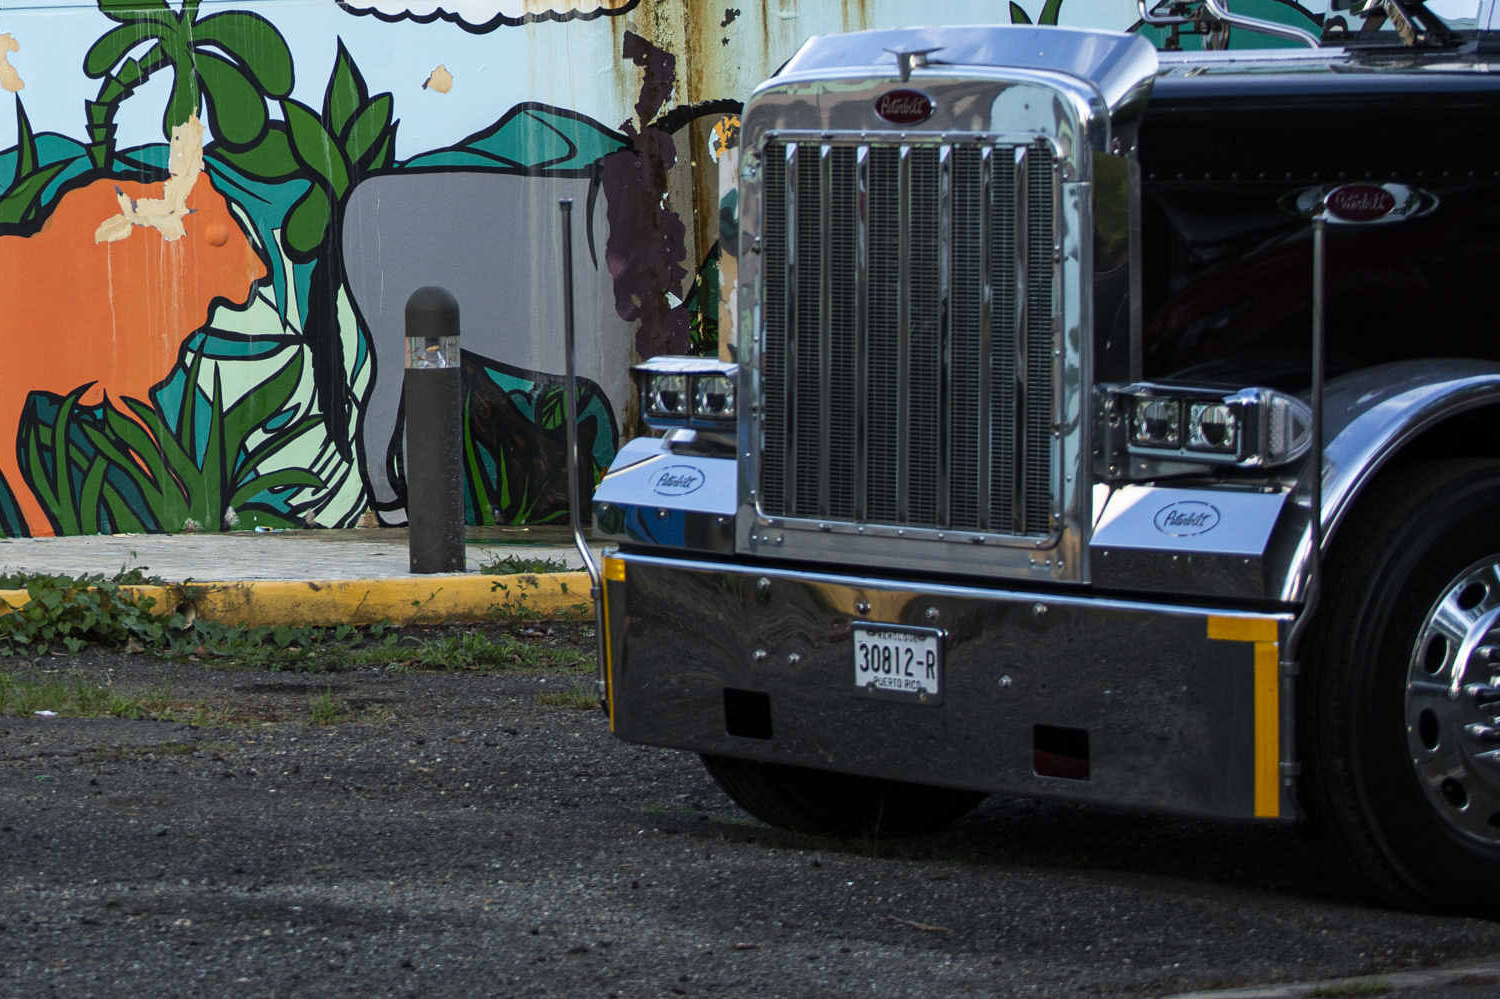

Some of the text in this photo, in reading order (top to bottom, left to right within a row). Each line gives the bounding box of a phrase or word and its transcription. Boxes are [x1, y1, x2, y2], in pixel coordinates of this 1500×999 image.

[880, 95, 926, 115] Peterbilt
[1334, 191, 1389, 211] Peterbilt
[656, 472, 698, 488] Peterbilt
[1163, 509, 1212, 527] Peterbilt
[859, 643, 936, 680] 30812-R
[873, 675, 921, 690] PUERTO RICO
